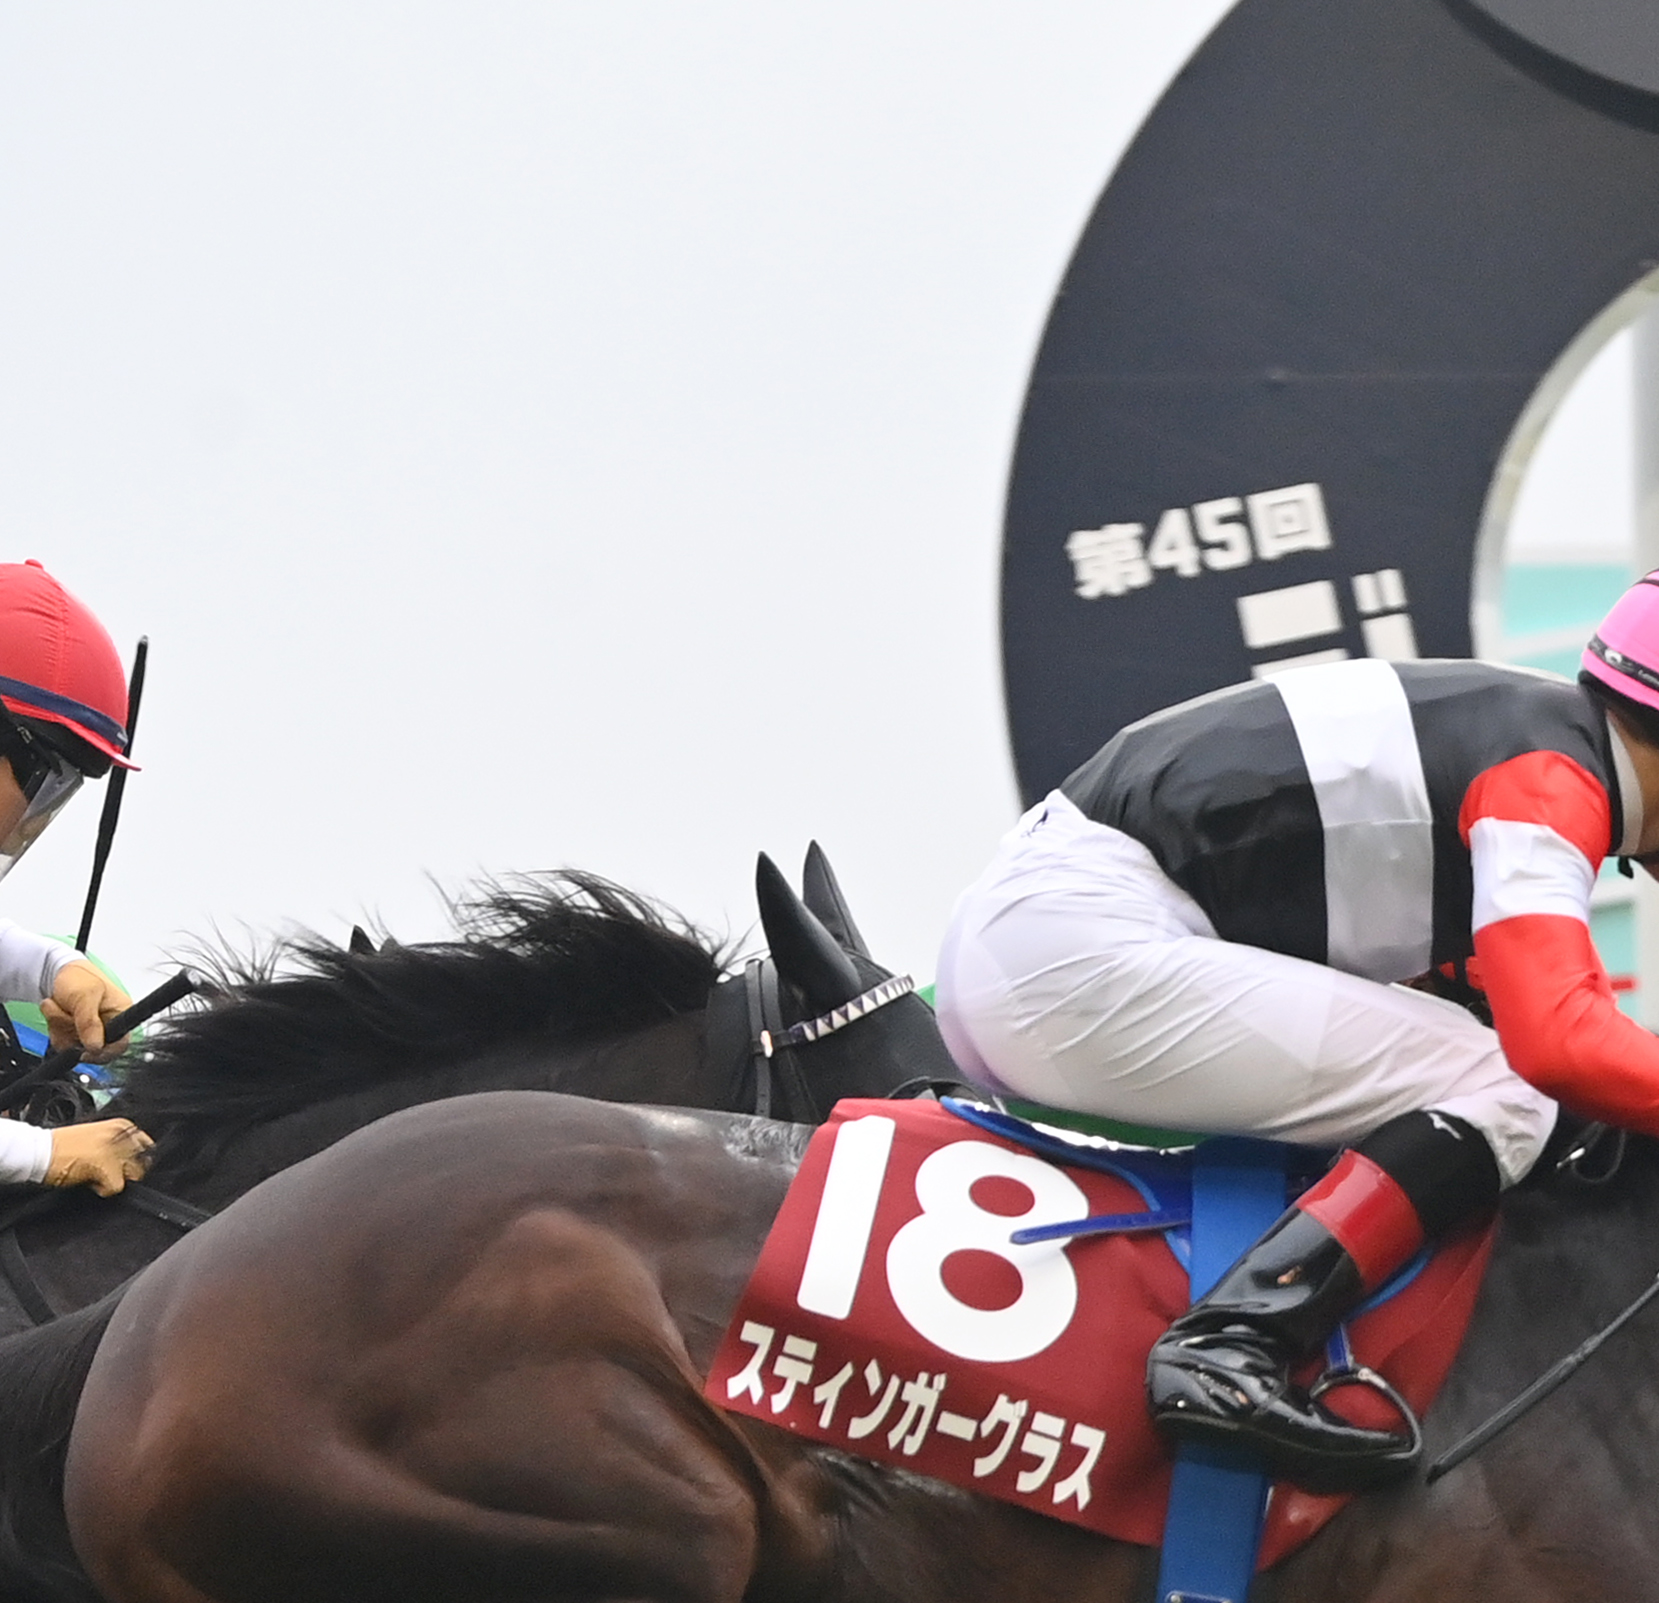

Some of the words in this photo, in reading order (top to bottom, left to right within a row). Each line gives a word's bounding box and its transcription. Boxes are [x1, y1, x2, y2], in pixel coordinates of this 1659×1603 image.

[1065, 482, 1332, 600] 第45回
[795, 1113, 1091, 1364] 18
[725, 1319, 1108, 1512] スティンガーグラス
